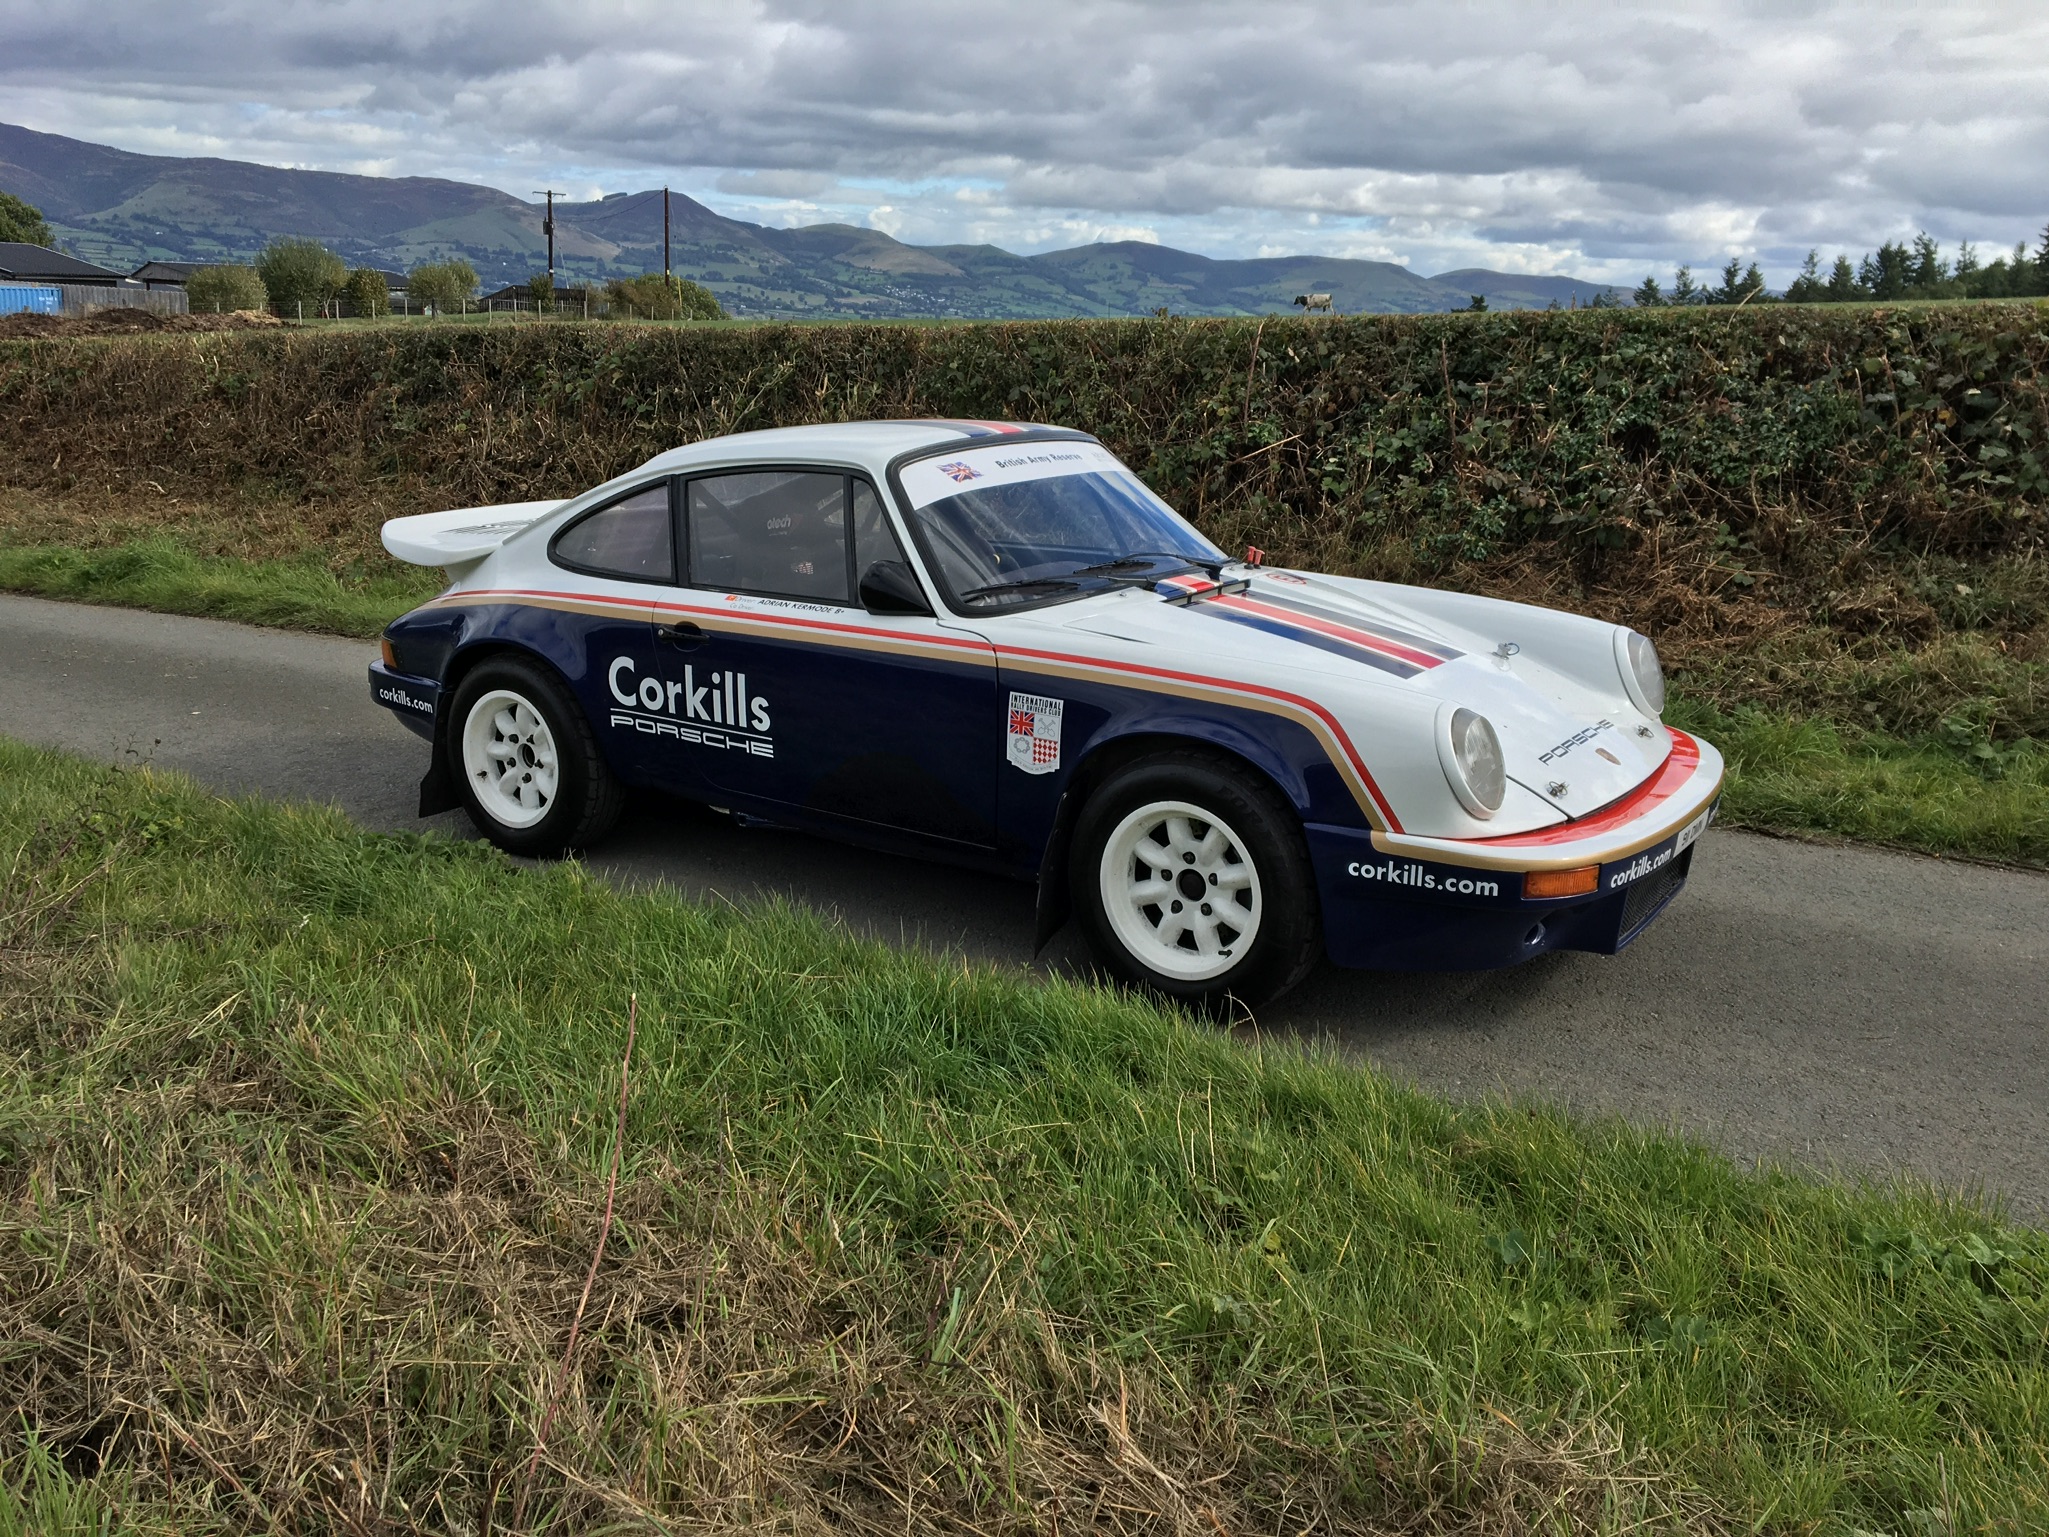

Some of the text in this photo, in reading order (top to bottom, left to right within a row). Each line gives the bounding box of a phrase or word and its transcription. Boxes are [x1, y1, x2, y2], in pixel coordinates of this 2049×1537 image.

[995, 457, 1028, 468] British
[1049, 453, 1083, 461] Reserve
[757, 599, 790, 609] ADRIAN
[791, 603, 834, 613] KERMODE
[379, 687, 434, 714] corkills.com
[608, 655, 771, 732] Corkills
[1010, 693, 1062, 711] INTERNATIONAL
[1010, 702, 1061, 717] RALLY DRIVERS CLUB
[610, 714, 775, 759] PORSCHE
[1538, 718, 1615, 766] PORSCHE
[1348, 860, 1499, 897] corkills.com
[1610, 848, 1672, 889] corkills.com
